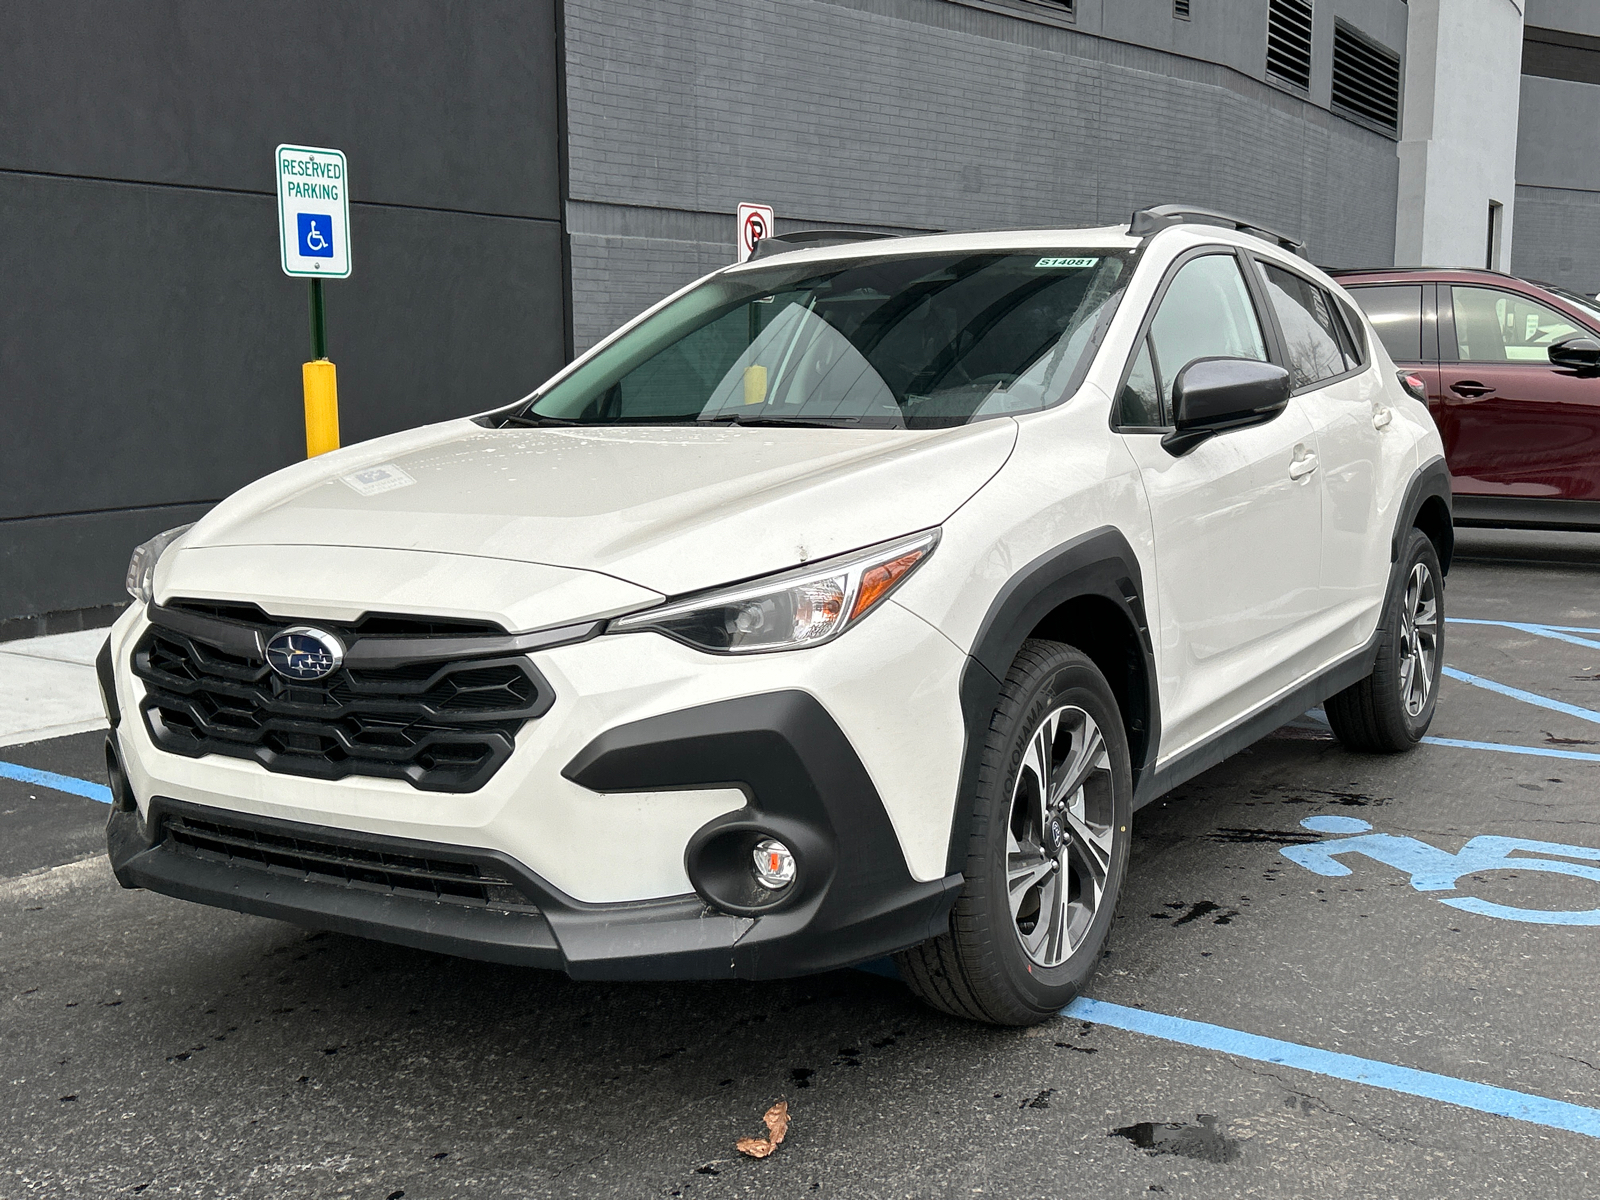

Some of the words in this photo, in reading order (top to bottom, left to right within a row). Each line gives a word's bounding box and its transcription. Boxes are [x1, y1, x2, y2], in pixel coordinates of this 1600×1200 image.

[283, 159, 341, 179] RESERVED
[288, 181, 339, 201] PARKING
[1040, 258, 1093, 266] S14081
[1001, 700, 1044, 804] YOKOHAMA
